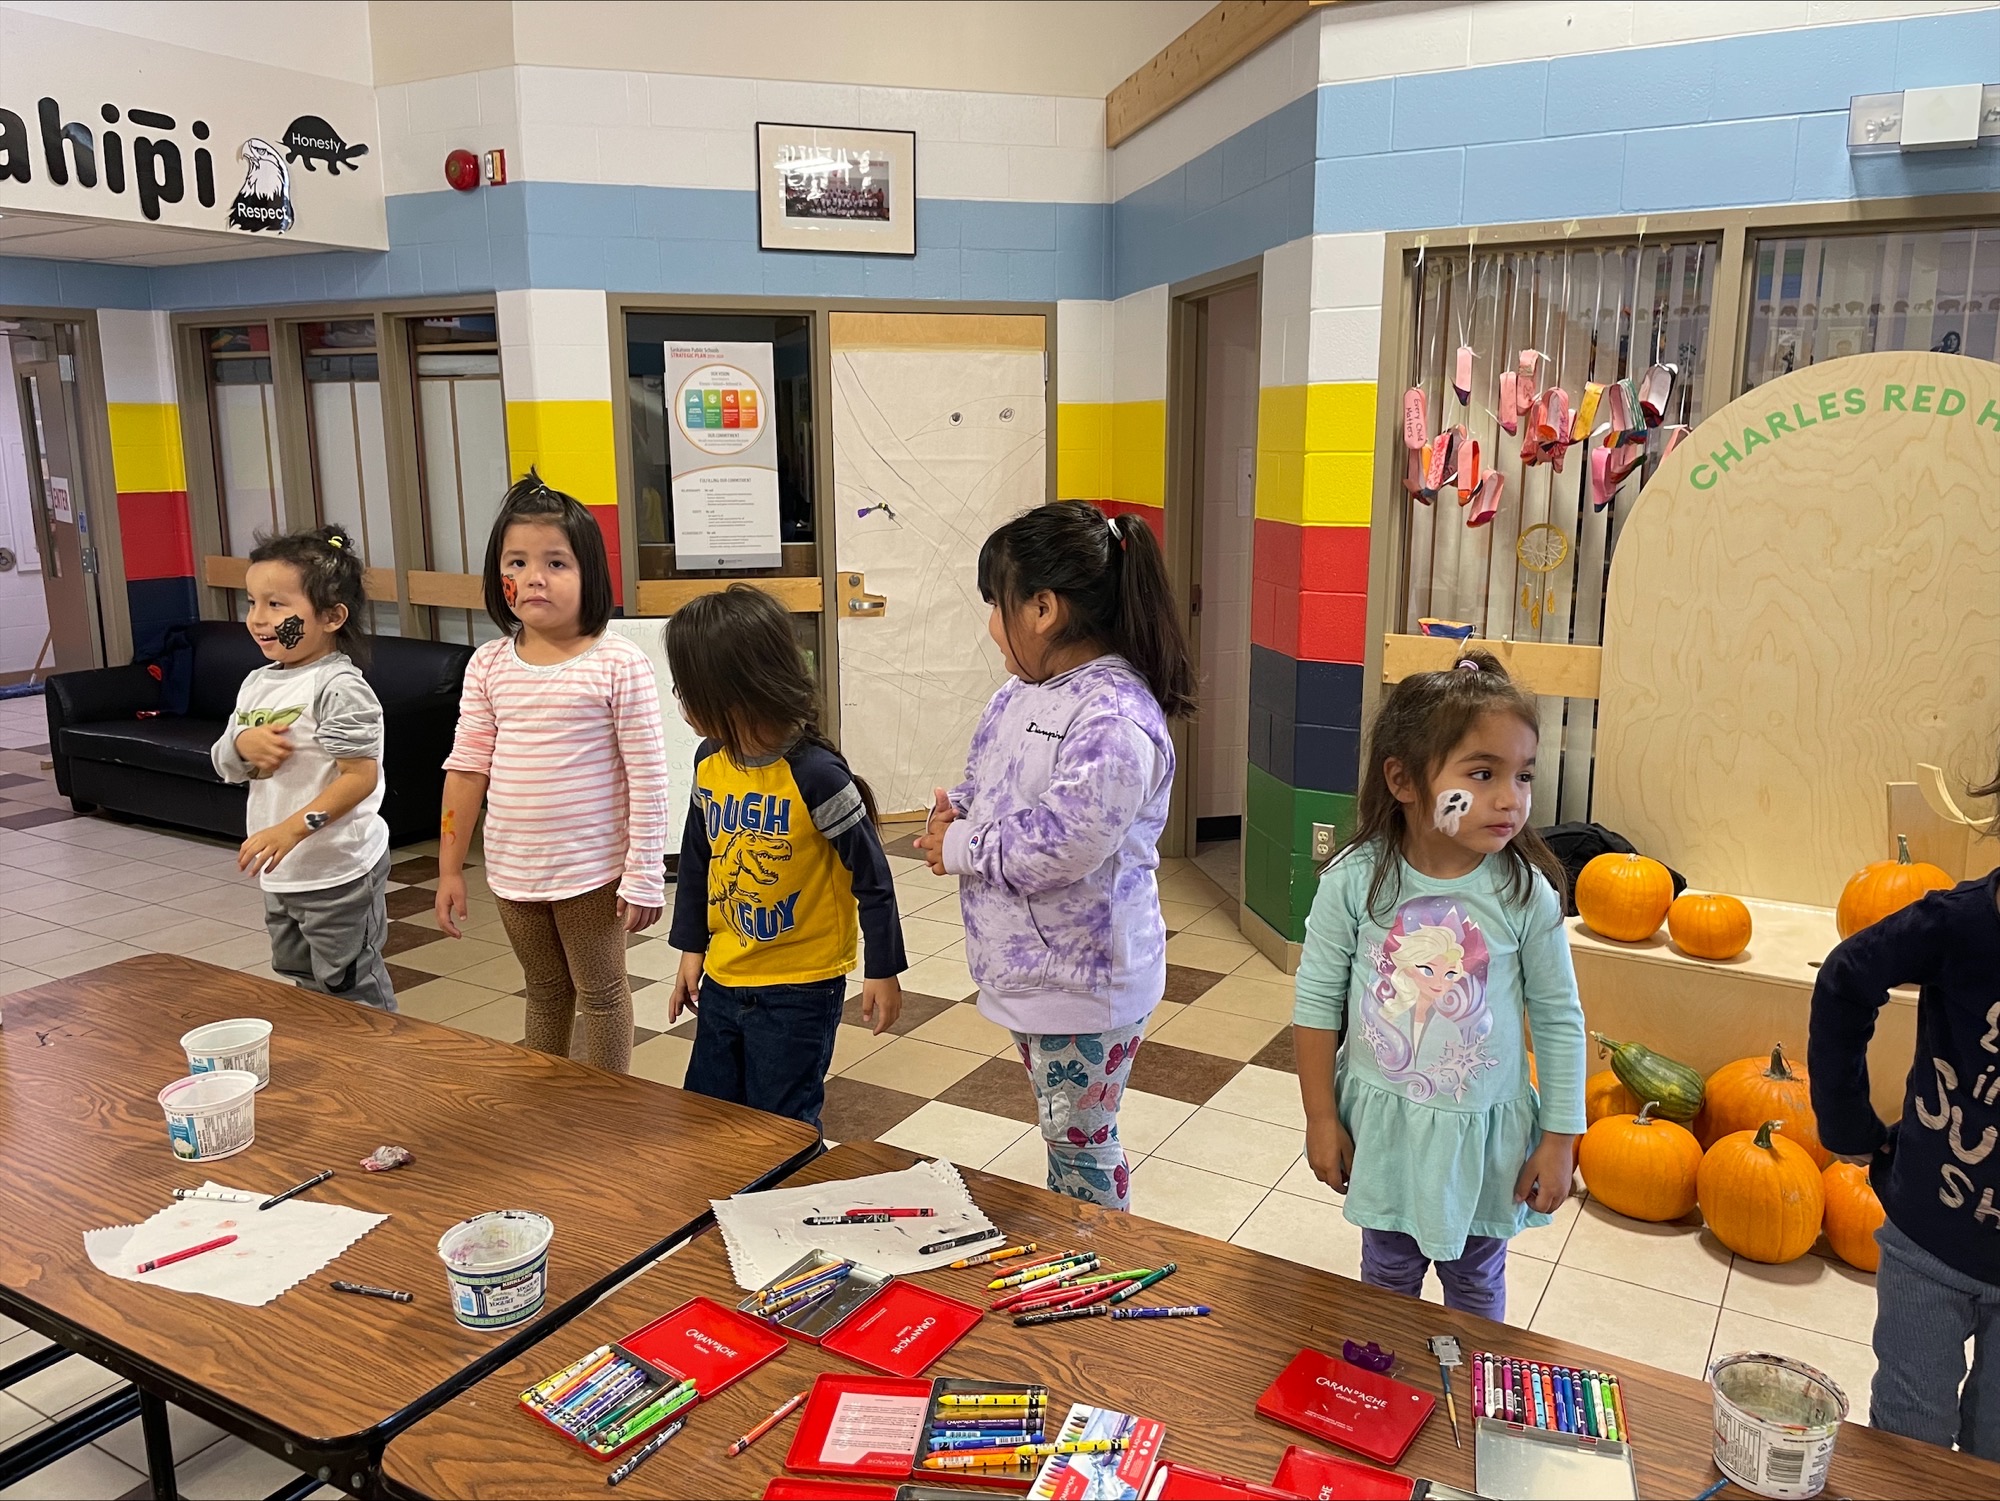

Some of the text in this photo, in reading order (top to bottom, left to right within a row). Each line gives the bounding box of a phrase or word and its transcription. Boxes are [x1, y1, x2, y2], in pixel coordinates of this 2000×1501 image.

[291, 132, 342, 154] Honesty
[237, 201, 288, 222] Respect
[1405, 407, 1414, 439] Matters
[1413, 398, 1424, 441] Every Child
[1690, 388, 1866, 490] CHARLES
[1883, 384, 1966, 417] RED
[698, 787, 791, 841] TOUGH
[738, 889, 802, 942] GUY
[502, 1273, 533, 1288] KIRKLAND
[686, 1328, 714, 1346] CARAN
[911, 1316, 936, 1339] CARAN
[1316, 1376, 1353, 1395] CARAN
